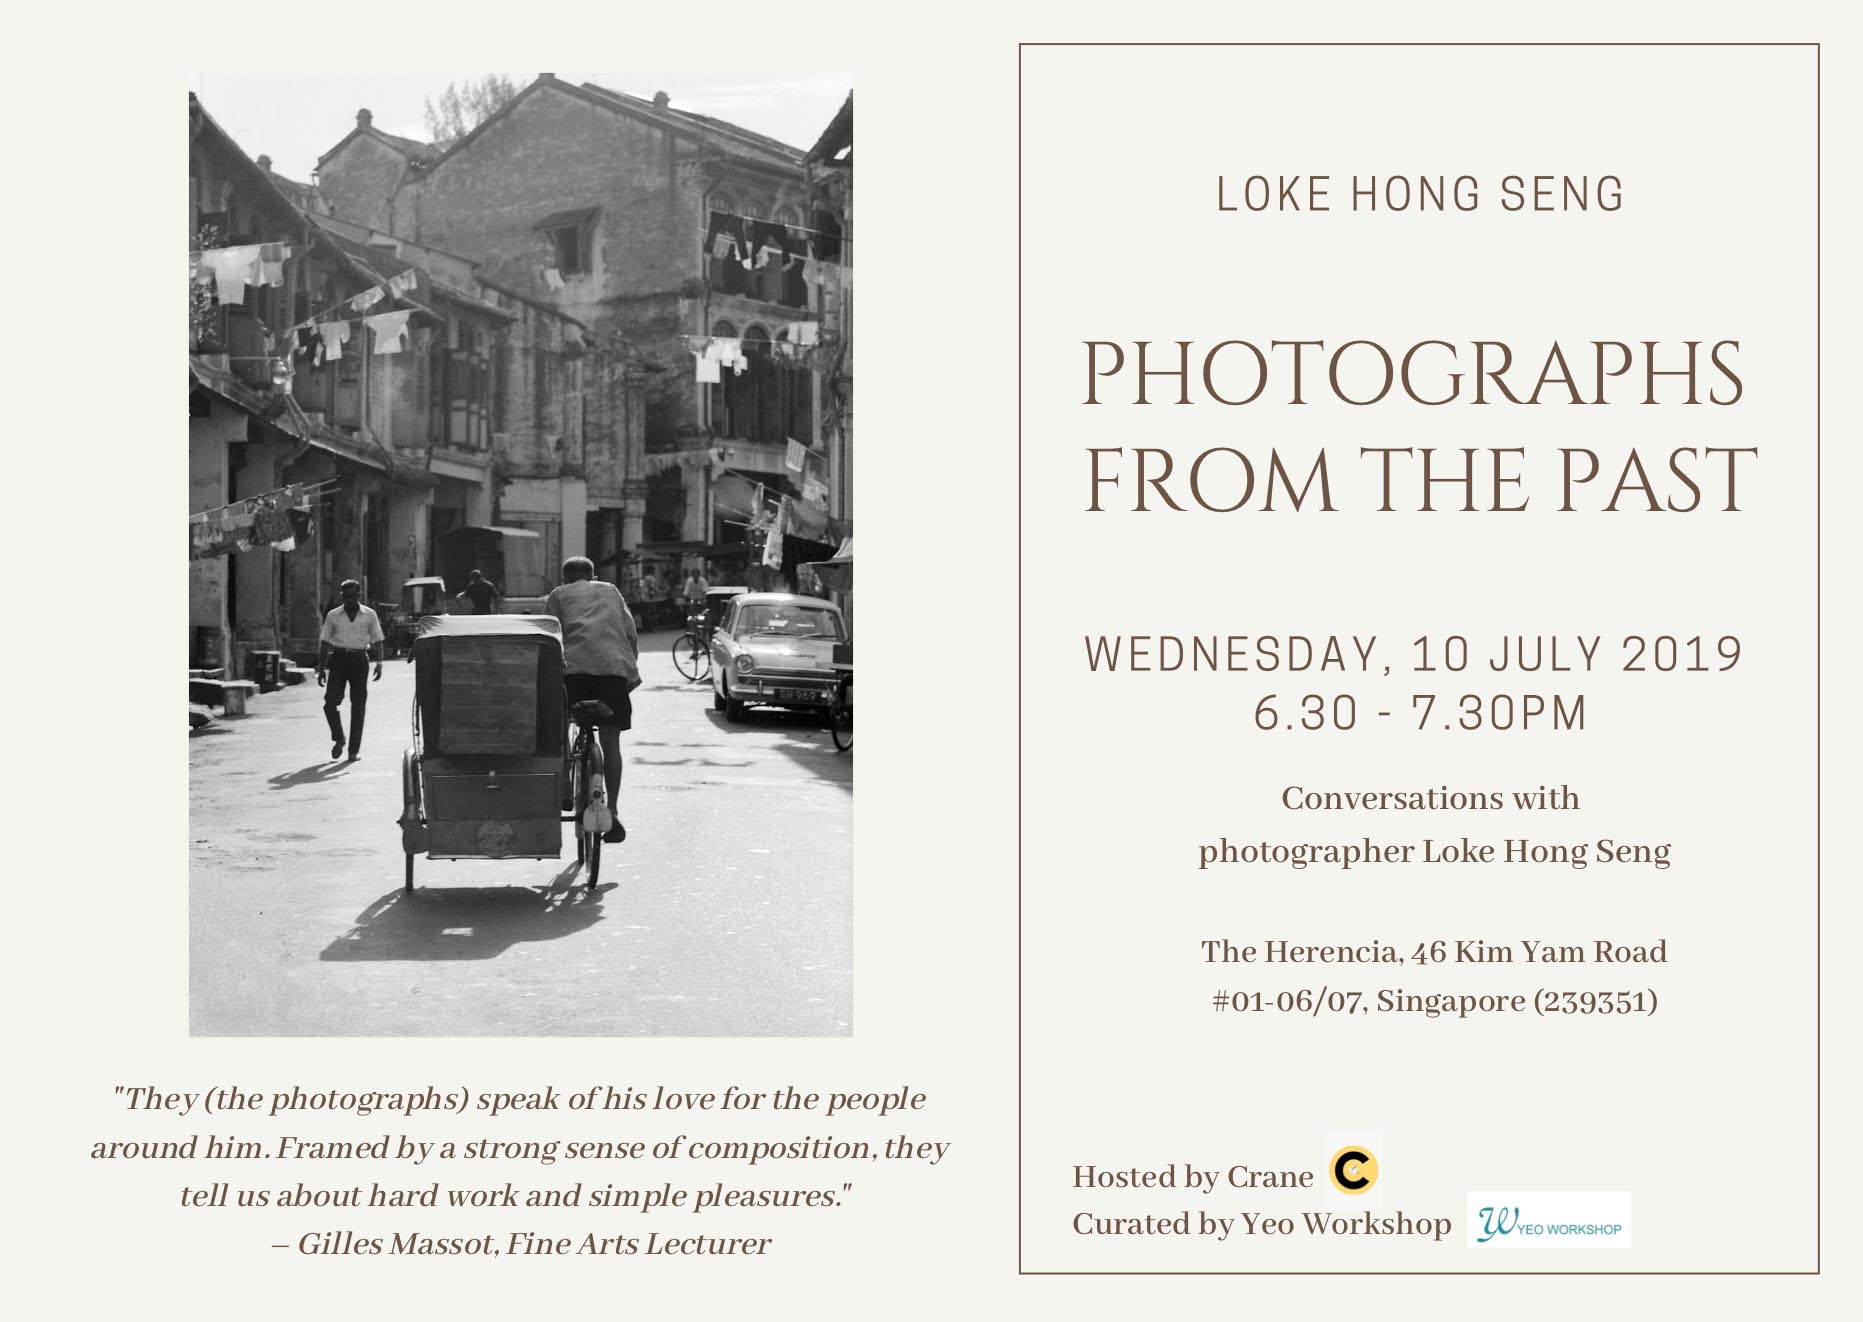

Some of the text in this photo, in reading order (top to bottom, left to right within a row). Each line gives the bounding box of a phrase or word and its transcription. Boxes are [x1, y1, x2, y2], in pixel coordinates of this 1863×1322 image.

[1218, 174, 1622, 212] LOKE HONG SENG
[1081, 339, 1743, 406] PHOTOGRAPHS
[1084, 446, 1759, 513] FROM THE PAST
[1084, 635, 1741, 677] WEDNESDAY, 10 JULY 2019
[1254, 693, 1356, 731] 6.30
[1412, 693, 1585, 731] 7.30PM
[1281, 784, 1581, 810] Conversations with
[1198, 837, 1672, 870] photographer Loke Hong Seng
[1201, 938, 1669, 966] The Herencia, 46 Kim Yam Road
[1212, 985, 1658, 1019] #01-06/07, Singapore (239351)
[115, 1085, 927, 1117] "They (the photographs) speak of his love for the people
[90, 1134, 952, 1166] around him. Framed by a strong sense of composition, they
[1072, 1163, 1314, 1195] Hosted by Crane
[1334, 1150, 1371, 1191] C
[181, 1182, 853, 1214] tell us about hard work and simple pleasures."
[1072, 1210, 1452, 1242] Curated by Yeo Workshop
[1517, 1224, 1622, 1235] YEO WORKSHOP
[298, 1230, 384, 1255] Gilles
[387, 1232, 500, 1258] Massot,
[505, 1231, 572, 1255] Fine
[575, 1232, 640, 1256] Arts
[644, 1232, 773, 1255] Lecturer
